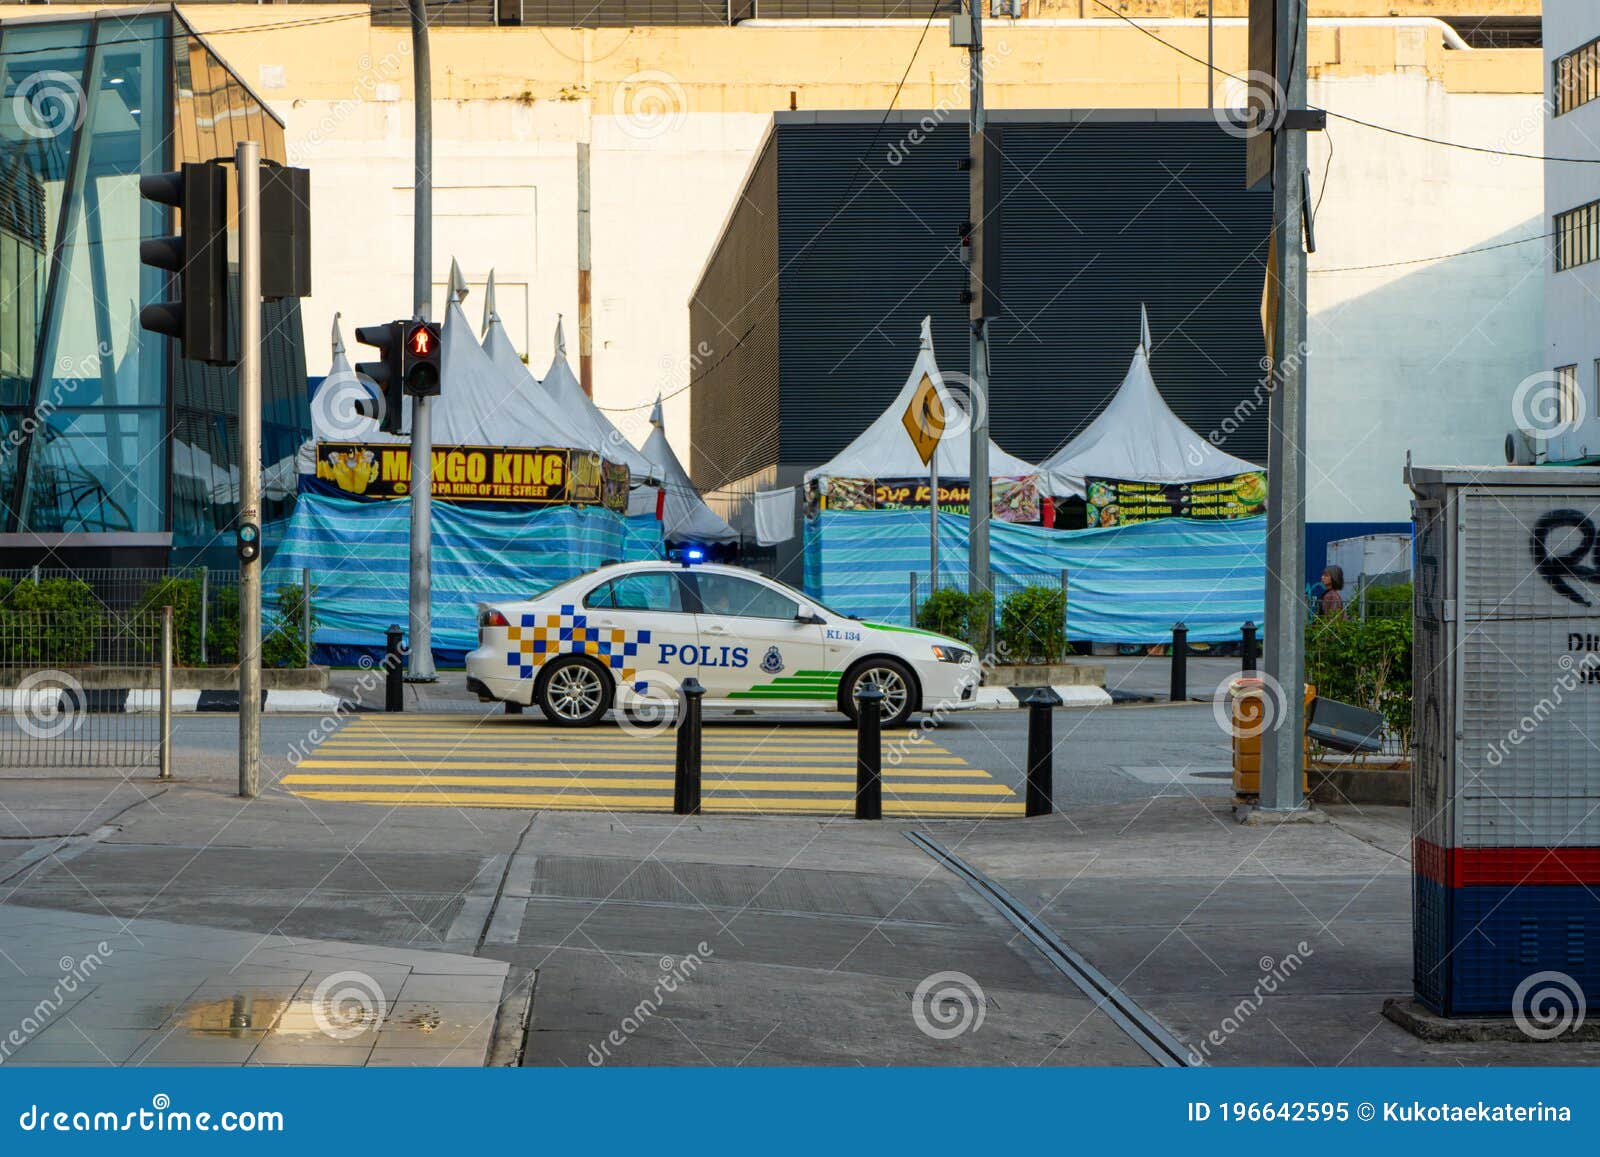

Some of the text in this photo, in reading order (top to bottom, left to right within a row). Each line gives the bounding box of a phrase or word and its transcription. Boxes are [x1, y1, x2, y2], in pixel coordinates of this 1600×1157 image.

[382, 450, 563, 486] MNGO KING
[453, 483, 477, 495] KING
[479, 484, 492, 495] OF
[493, 485, 512, 496] THE
[513, 485, 549, 497] STREET
[876, 486, 970, 501] SUP KDAH
[1192, 506, 1217, 516] Cendol
[826, 630, 861, 641] KL 134
[657, 643, 749, 668] POLIS
